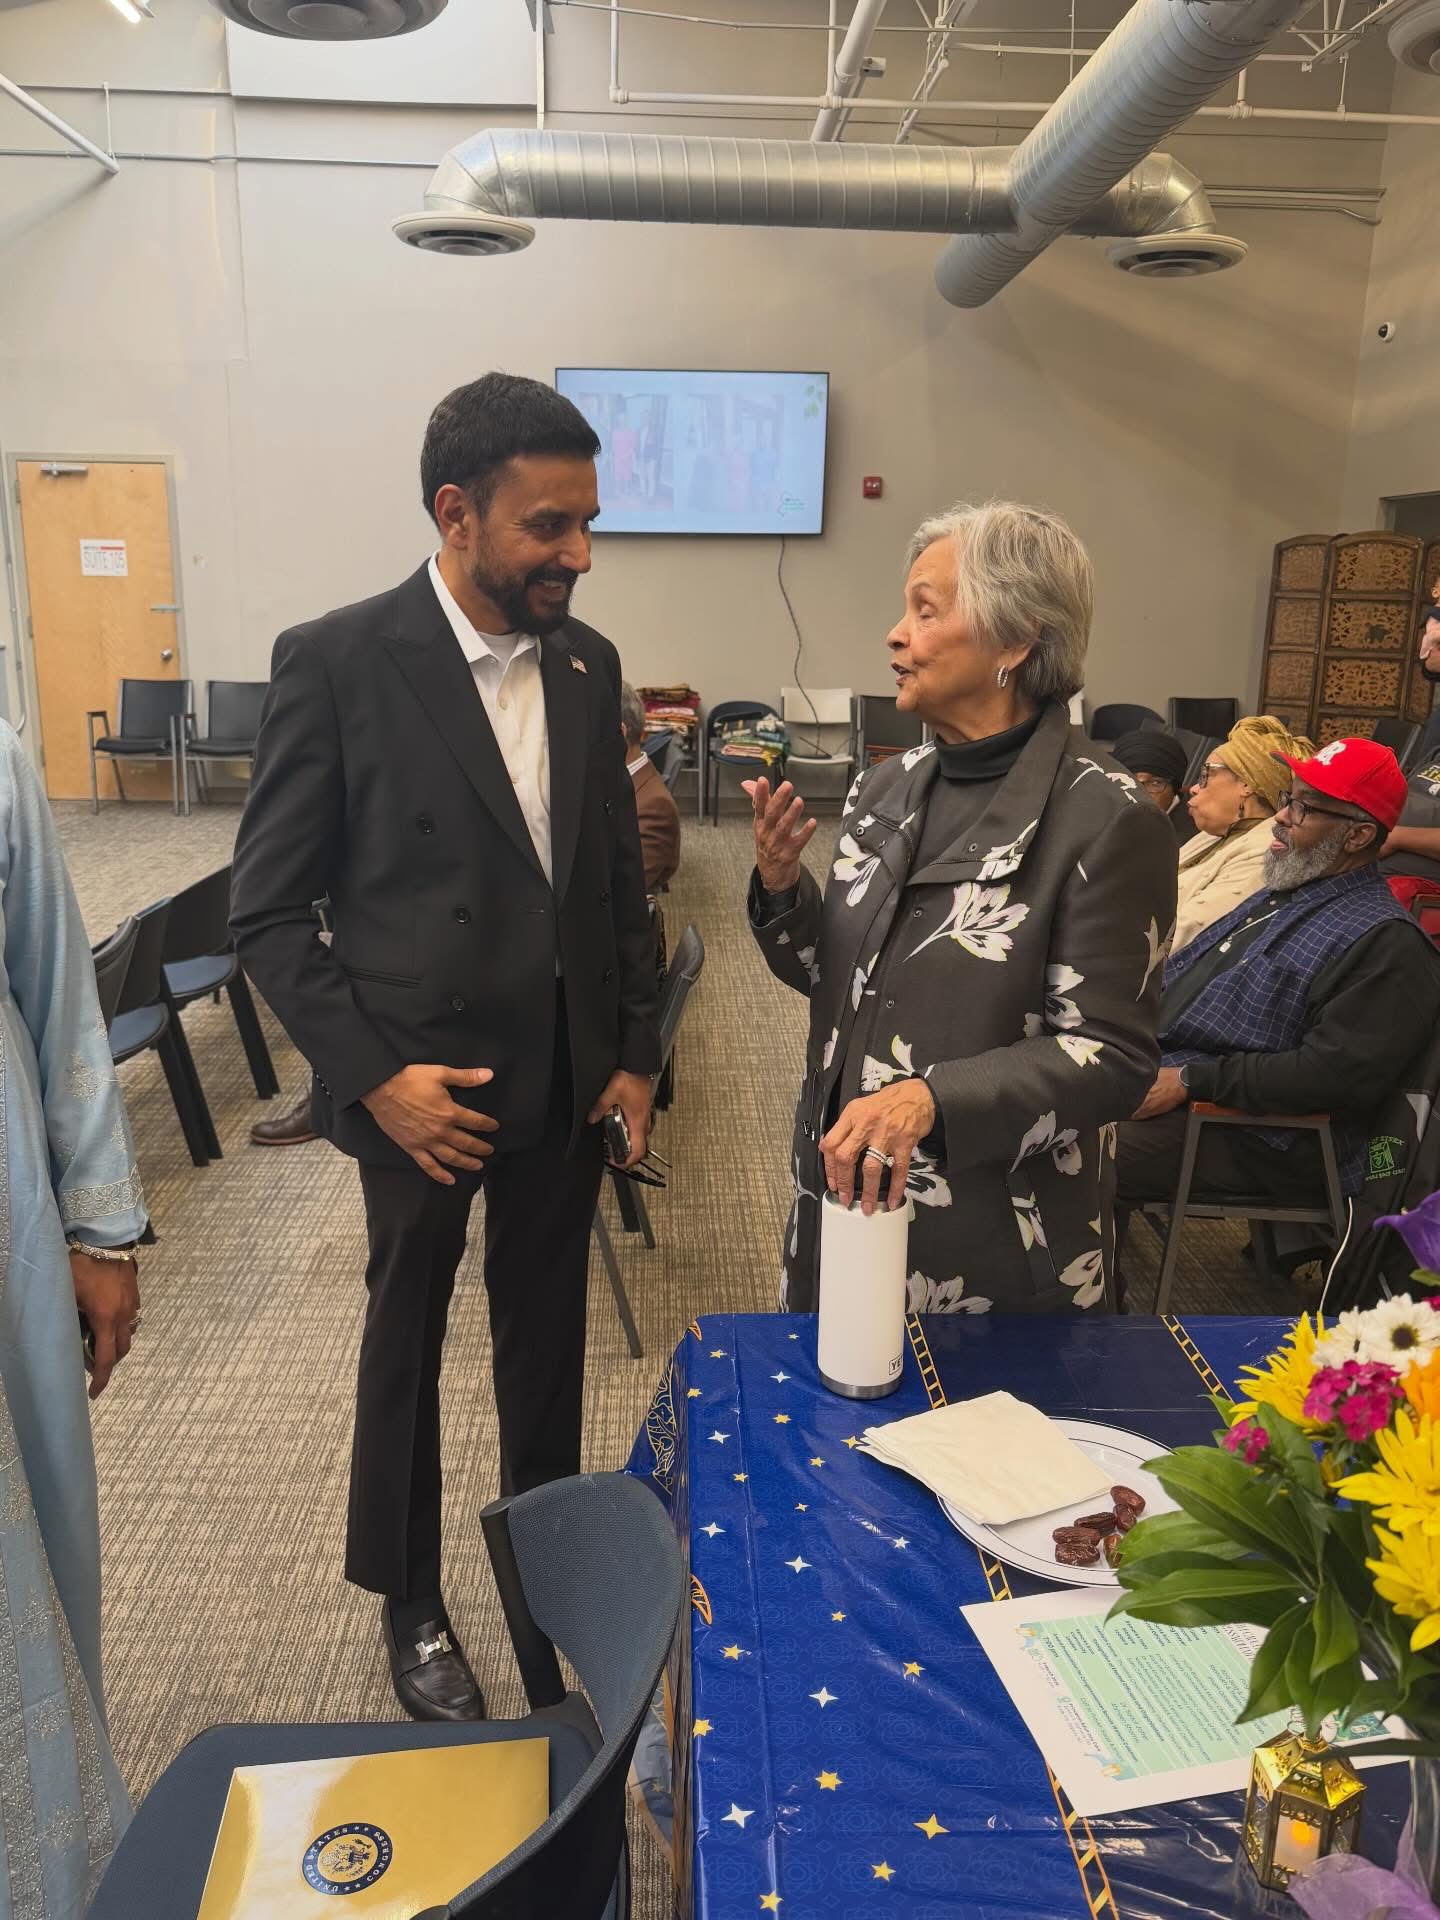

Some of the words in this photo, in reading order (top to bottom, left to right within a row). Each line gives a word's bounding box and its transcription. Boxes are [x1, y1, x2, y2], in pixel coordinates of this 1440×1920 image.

[84, 551, 107, 569] SUITE
[366, 1830, 390, 1882] CONGRESS
[305, 1864, 339, 1893] UNITED
